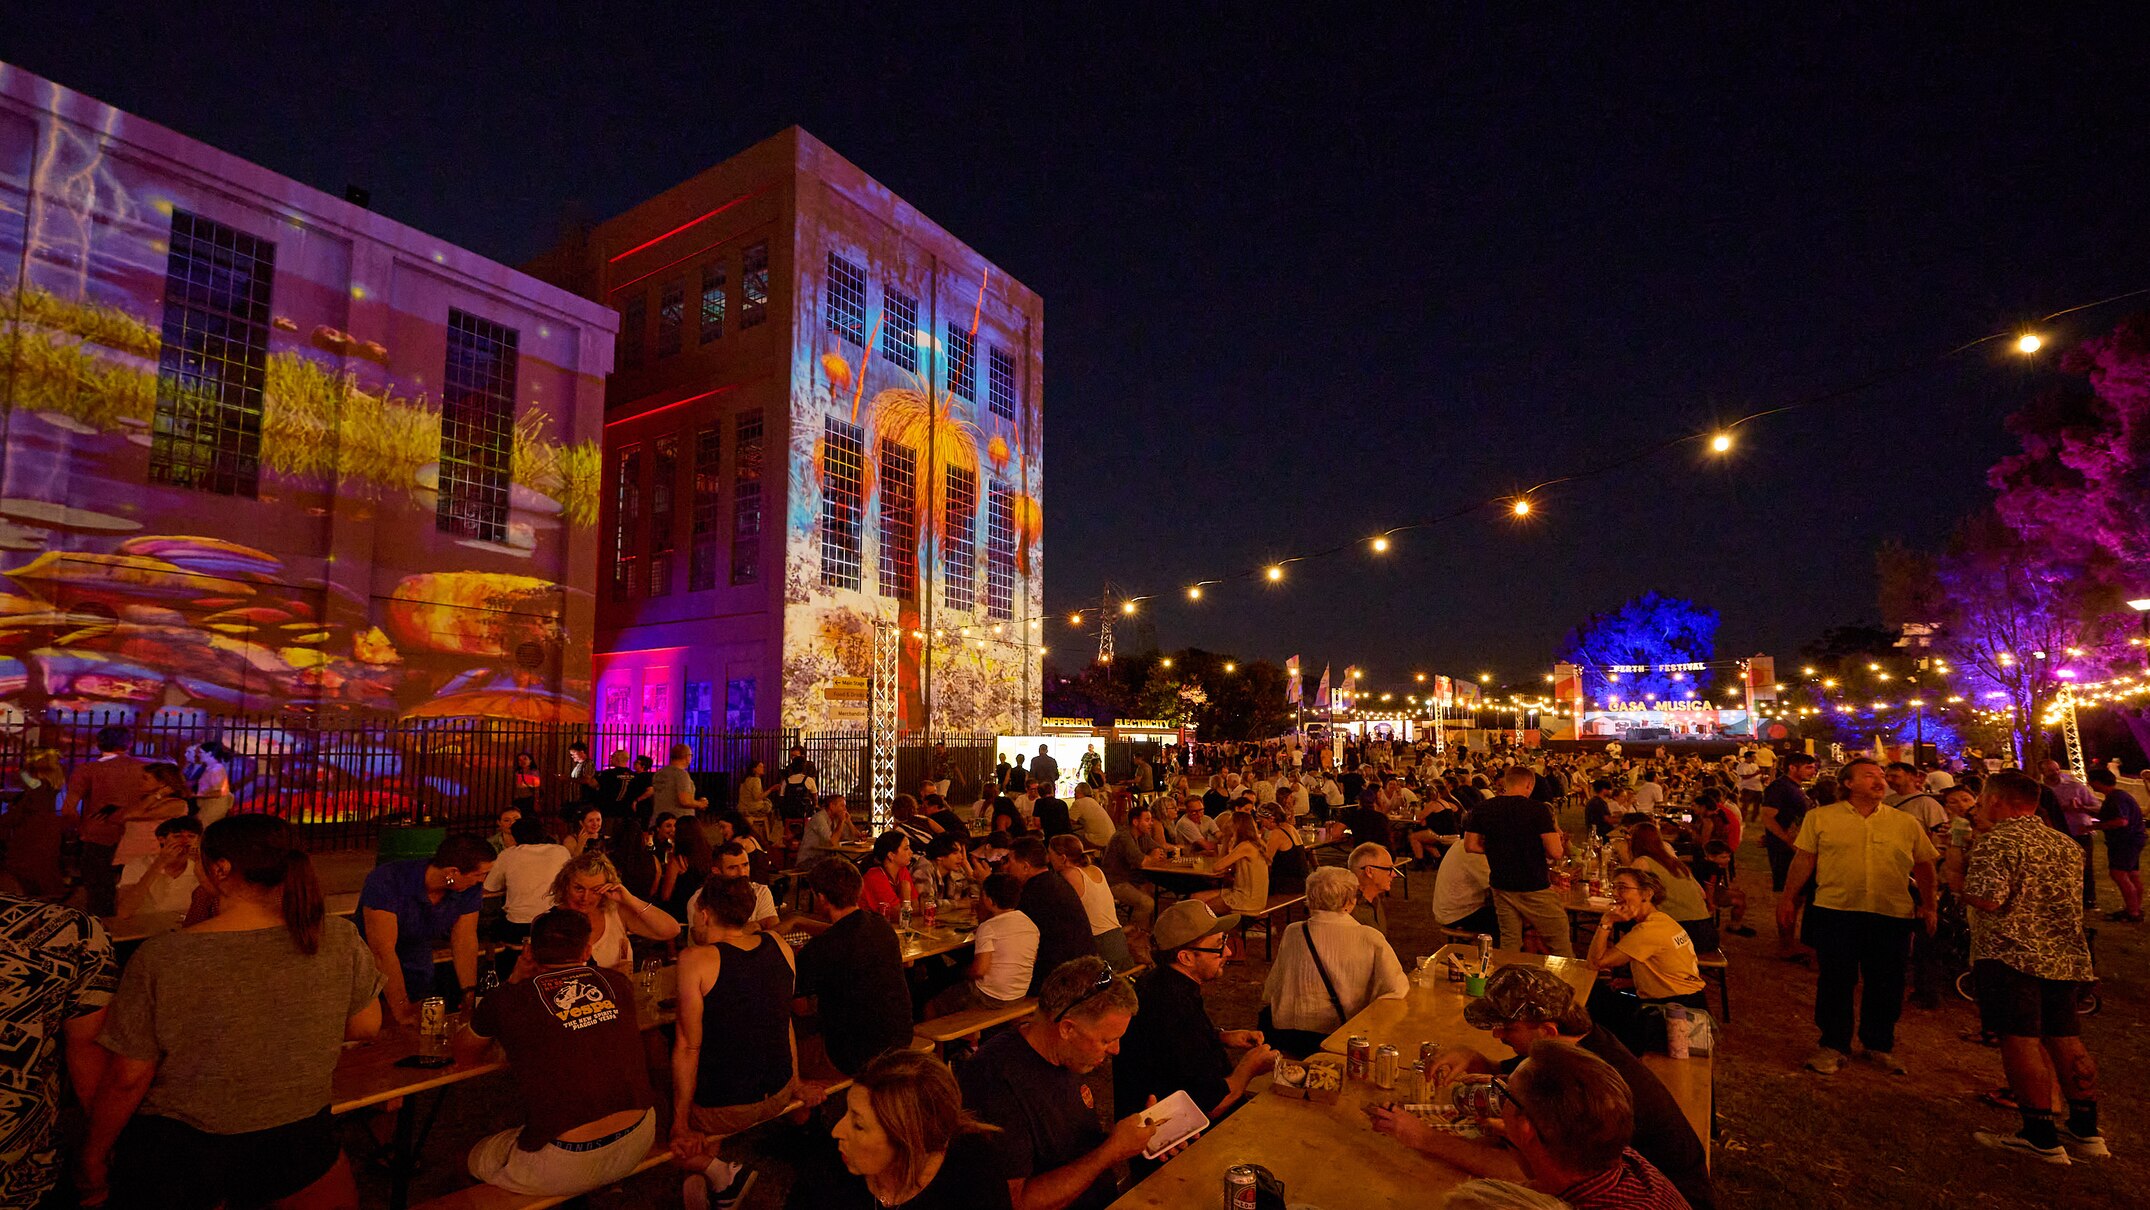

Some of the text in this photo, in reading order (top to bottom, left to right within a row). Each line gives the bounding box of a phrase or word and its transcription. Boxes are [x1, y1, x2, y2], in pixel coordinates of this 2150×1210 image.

[1613, 663, 1706, 673] PERTH FESTIVAL
[1608, 701, 1713, 711] CASA MUSICA
[1042, 717, 1170, 728] DIFFERENT ELECTRICITY
[563, 1019, 577, 1028] THE
[578, 1015, 592, 1024] NEW
[593, 1010, 612, 1019] SPIRIT
[573, 1014, 617, 1030] PIAGGIO VESPA
